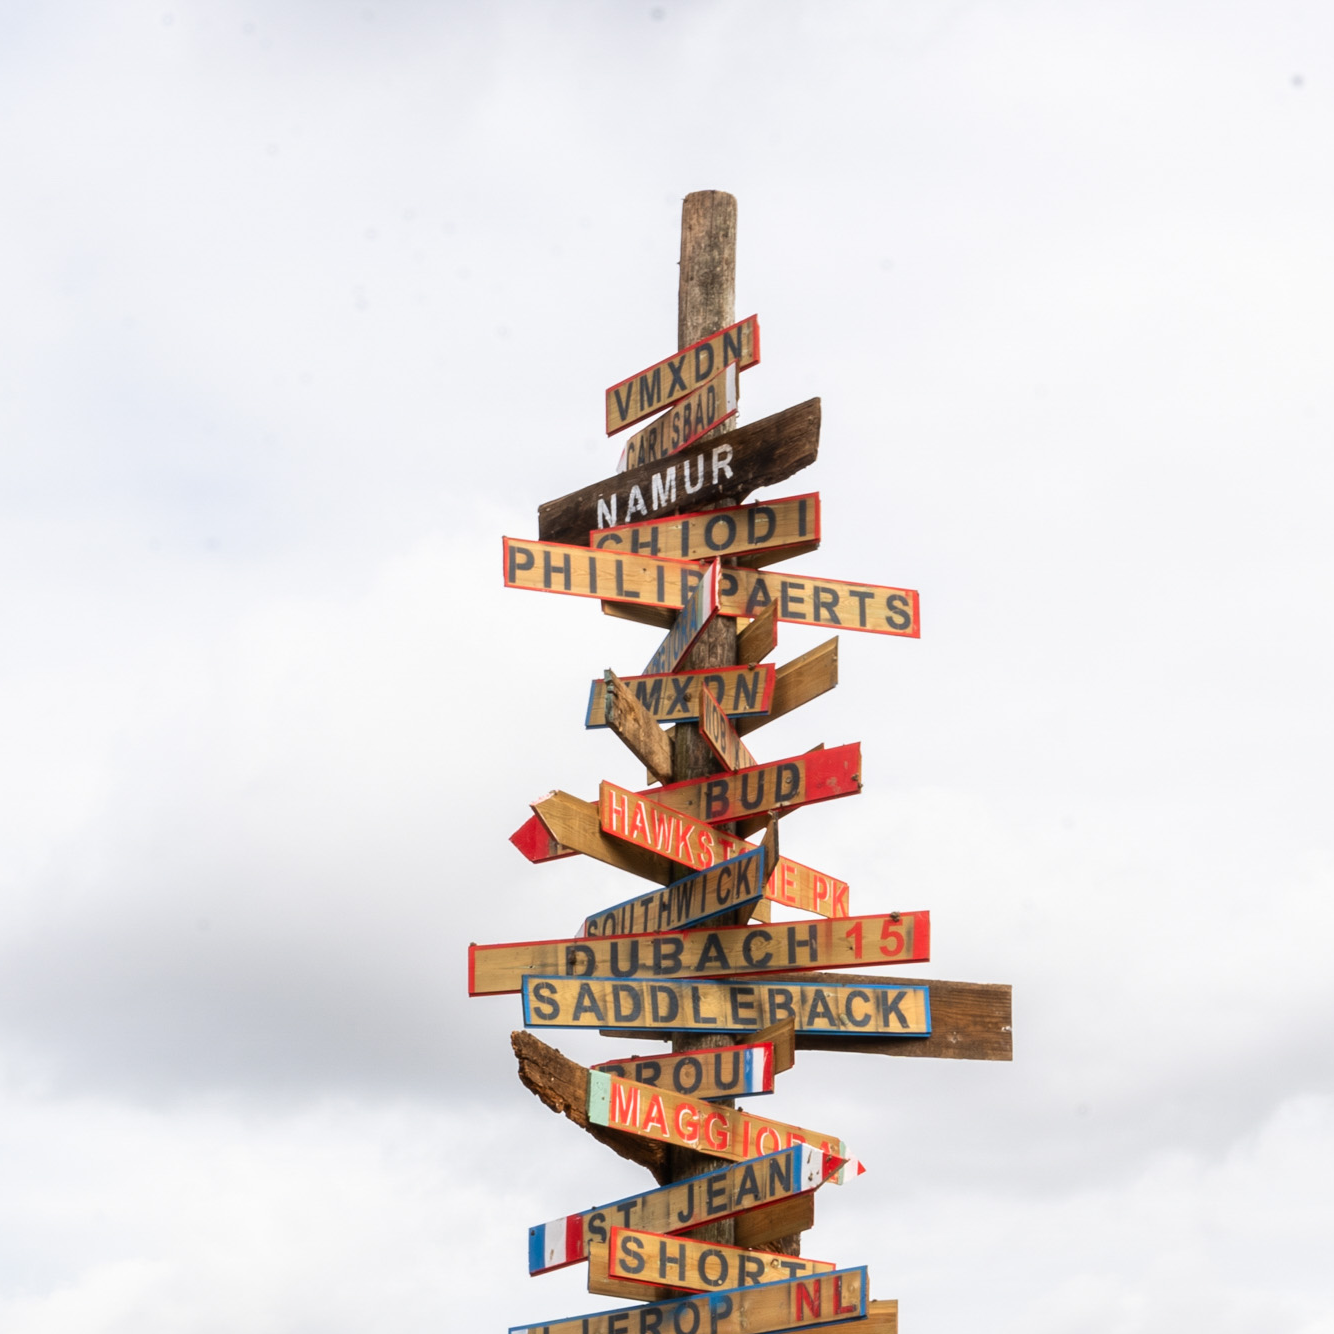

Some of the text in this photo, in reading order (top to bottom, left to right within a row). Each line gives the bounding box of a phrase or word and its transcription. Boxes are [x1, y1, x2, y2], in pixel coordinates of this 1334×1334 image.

[614, 326, 742, 422] VMXDN
[627, 385, 716, 470] CARLSBAD
[597, 443, 734, 529] NAMUR
[624, 671, 759, 716] MXDN
[705, 762, 800, 822] BUD
[609, 789, 849, 919] HAWKSTNE PK
[587, 857, 753, 938] SOUTHWICK
[565, 918, 906, 978] DUBACH 15
[533, 982, 910, 1028] SADDLEBACK
[588, 1151, 793, 1244] ST JEAN
[618, 1235, 806, 1287] SHORT
[795, 1275, 857, 1322] NL
